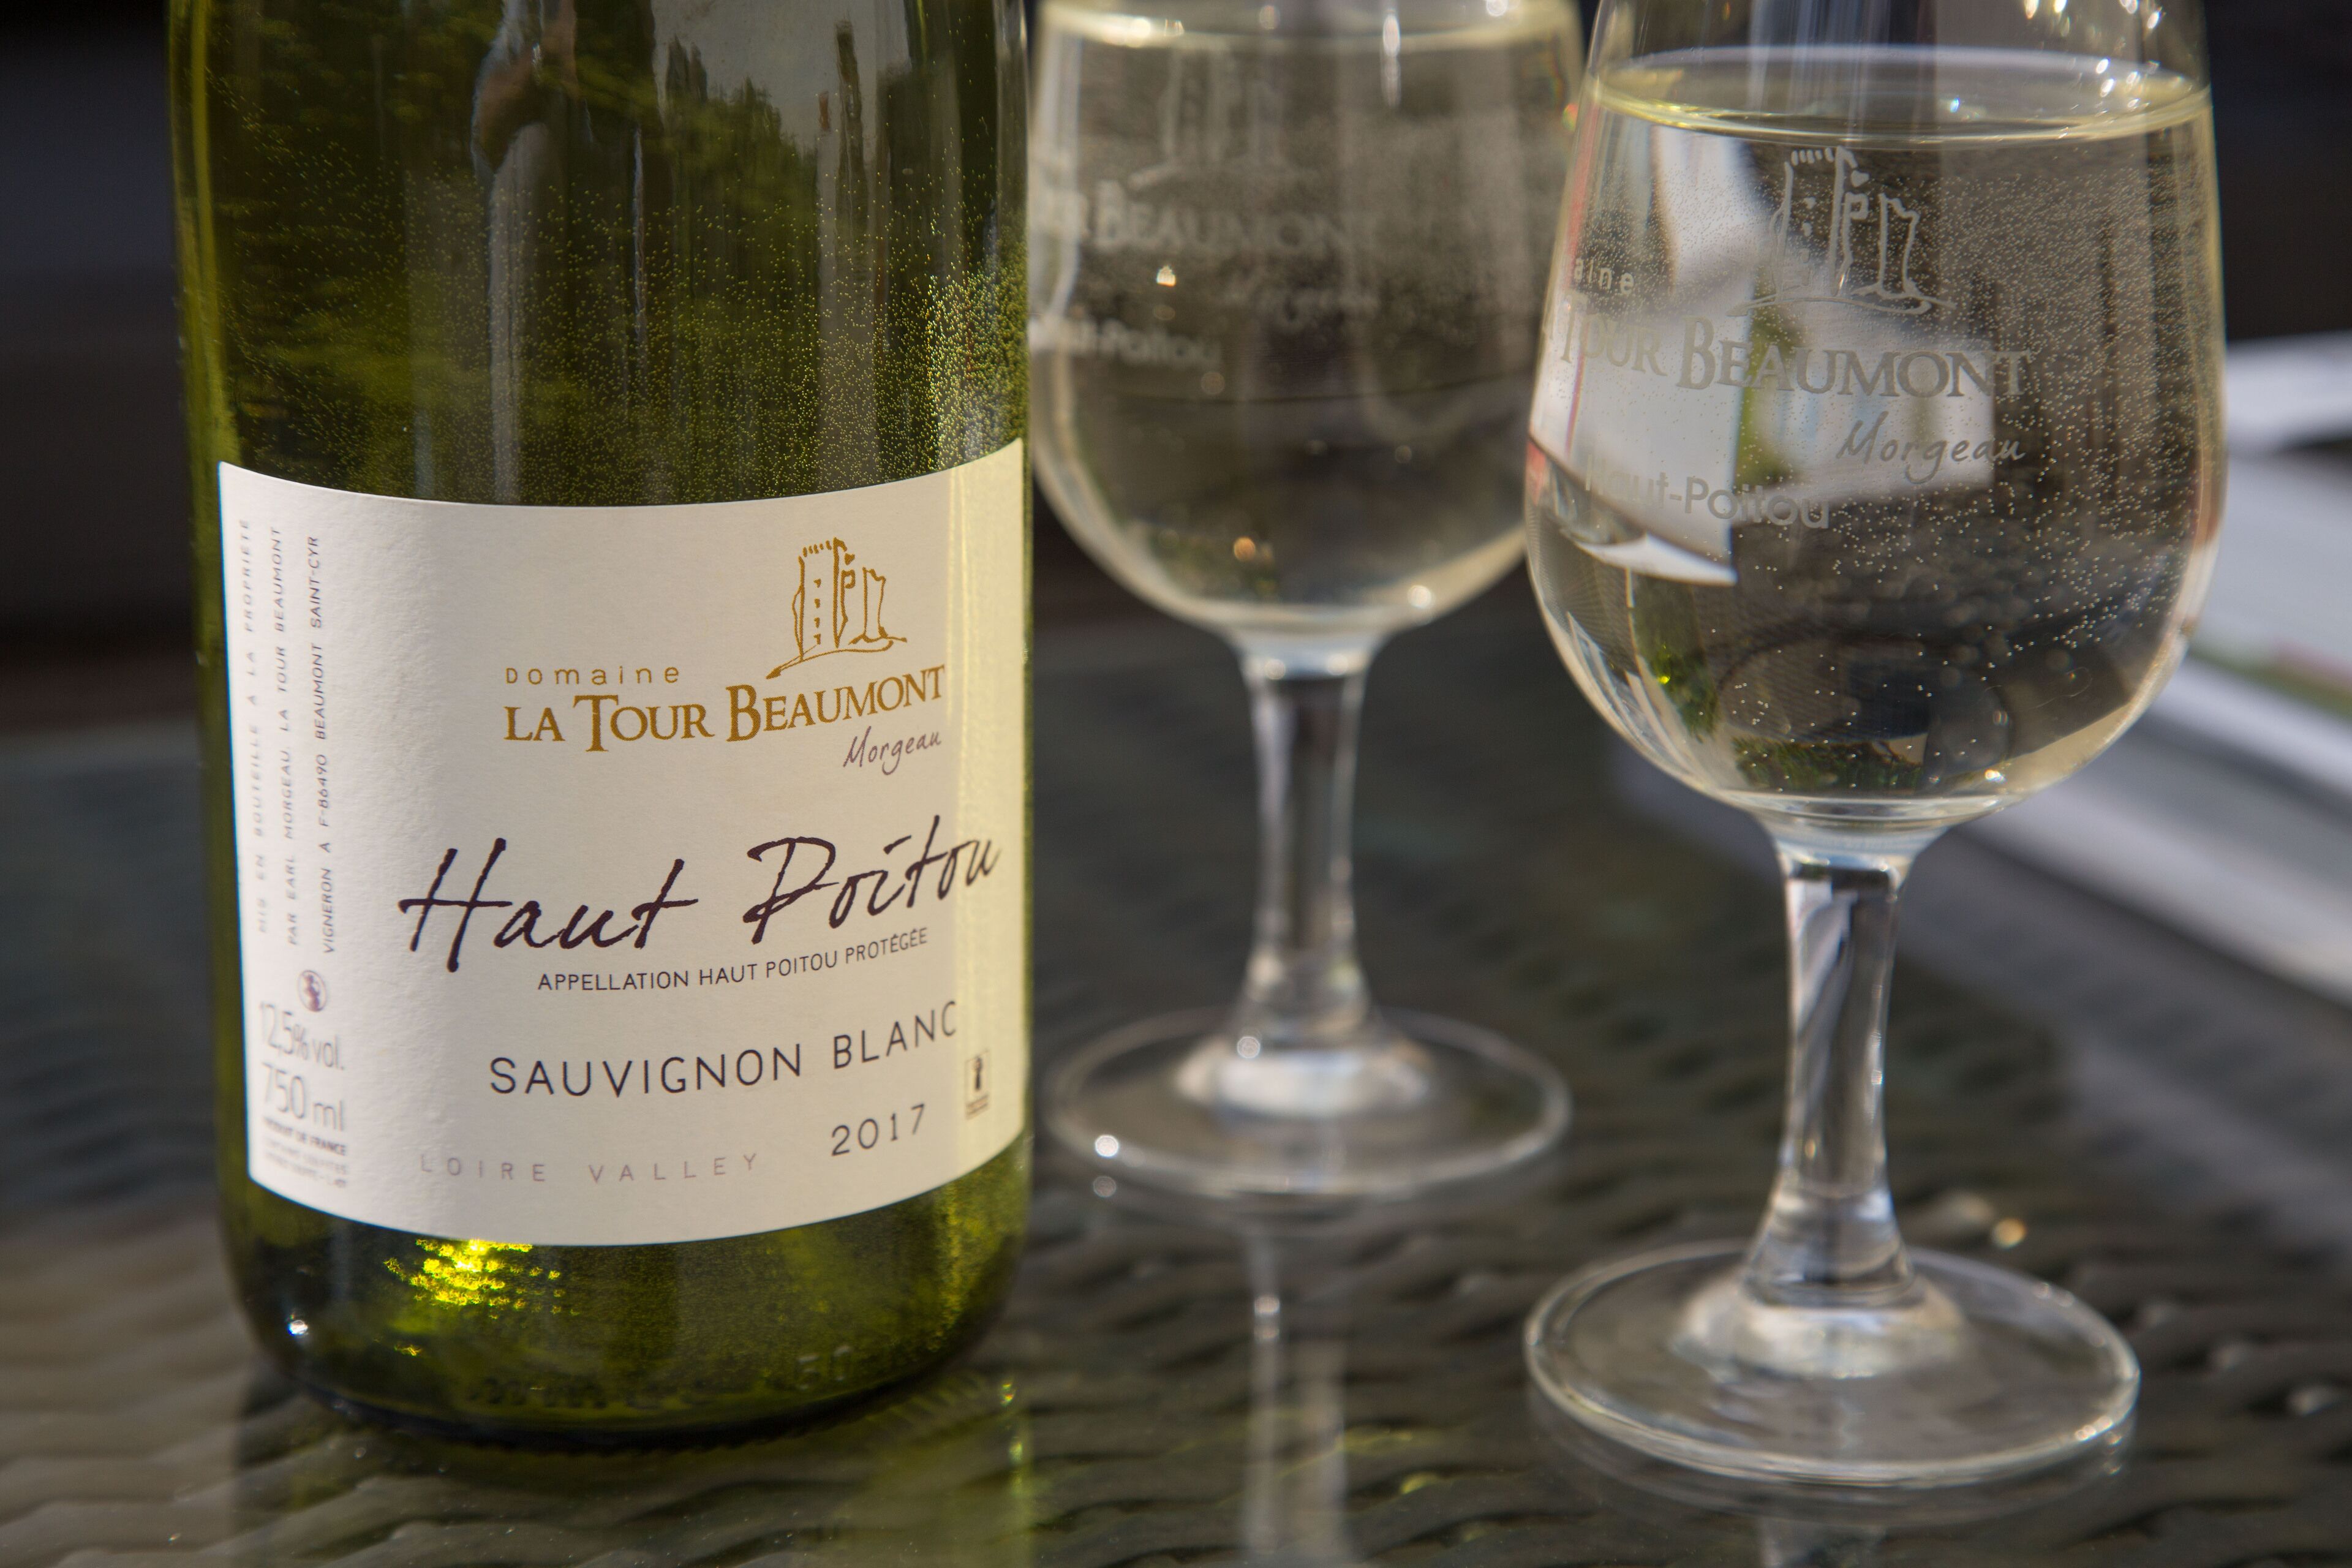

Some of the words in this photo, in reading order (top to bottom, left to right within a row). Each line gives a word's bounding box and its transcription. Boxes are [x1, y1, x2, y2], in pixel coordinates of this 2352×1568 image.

[1676, 314, 2034, 399] BEAUMONT
[1836, 410, 2026, 485] Morgeau
[271, 527, 285, 632] BEAUMONT
[307, 536, 323, 629] SAINT-CYR
[246, 652, 255, 676] LA
[275, 646, 286, 692] TOUR
[311, 643, 326, 740] BEAUMONT
[279, 709, 288, 731] LA
[503, 706, 565, 742] LA
[573, 694, 715, 753] TOUR
[725, 664, 946, 743] BEAUMONT
[249, 724, 262, 837] BOUTEILLE
[842, 725, 943, 776] Morgeau
[315, 754, 330, 827] F-86490
[285, 854, 296, 900] EARL
[320, 867, 335, 954] VIGNERON
[398, 837, 699, 974] Haut
[742, 814, 1002, 945] Poitou
[287, 913, 298, 946] PAR
[537, 971, 689, 992] APPELLATION
[698, 963, 757, 987] HAUT
[765, 949, 837, 978] POITOU
[845, 927, 928, 965] PROTÉGÉE
[489, 1043, 802, 1098] SAUVIGNON
[833, 1000, 956, 1071] BLANC
[261, 1061, 306, 1120] 750
[312, 1100, 344, 1131] ml
[830, 1104, 926, 1158] 2017
[310, 1136, 347, 1156] FRANCE
[420, 1154, 546, 1183] LOIRE
[587, 1153, 758, 1183] VALLEY
